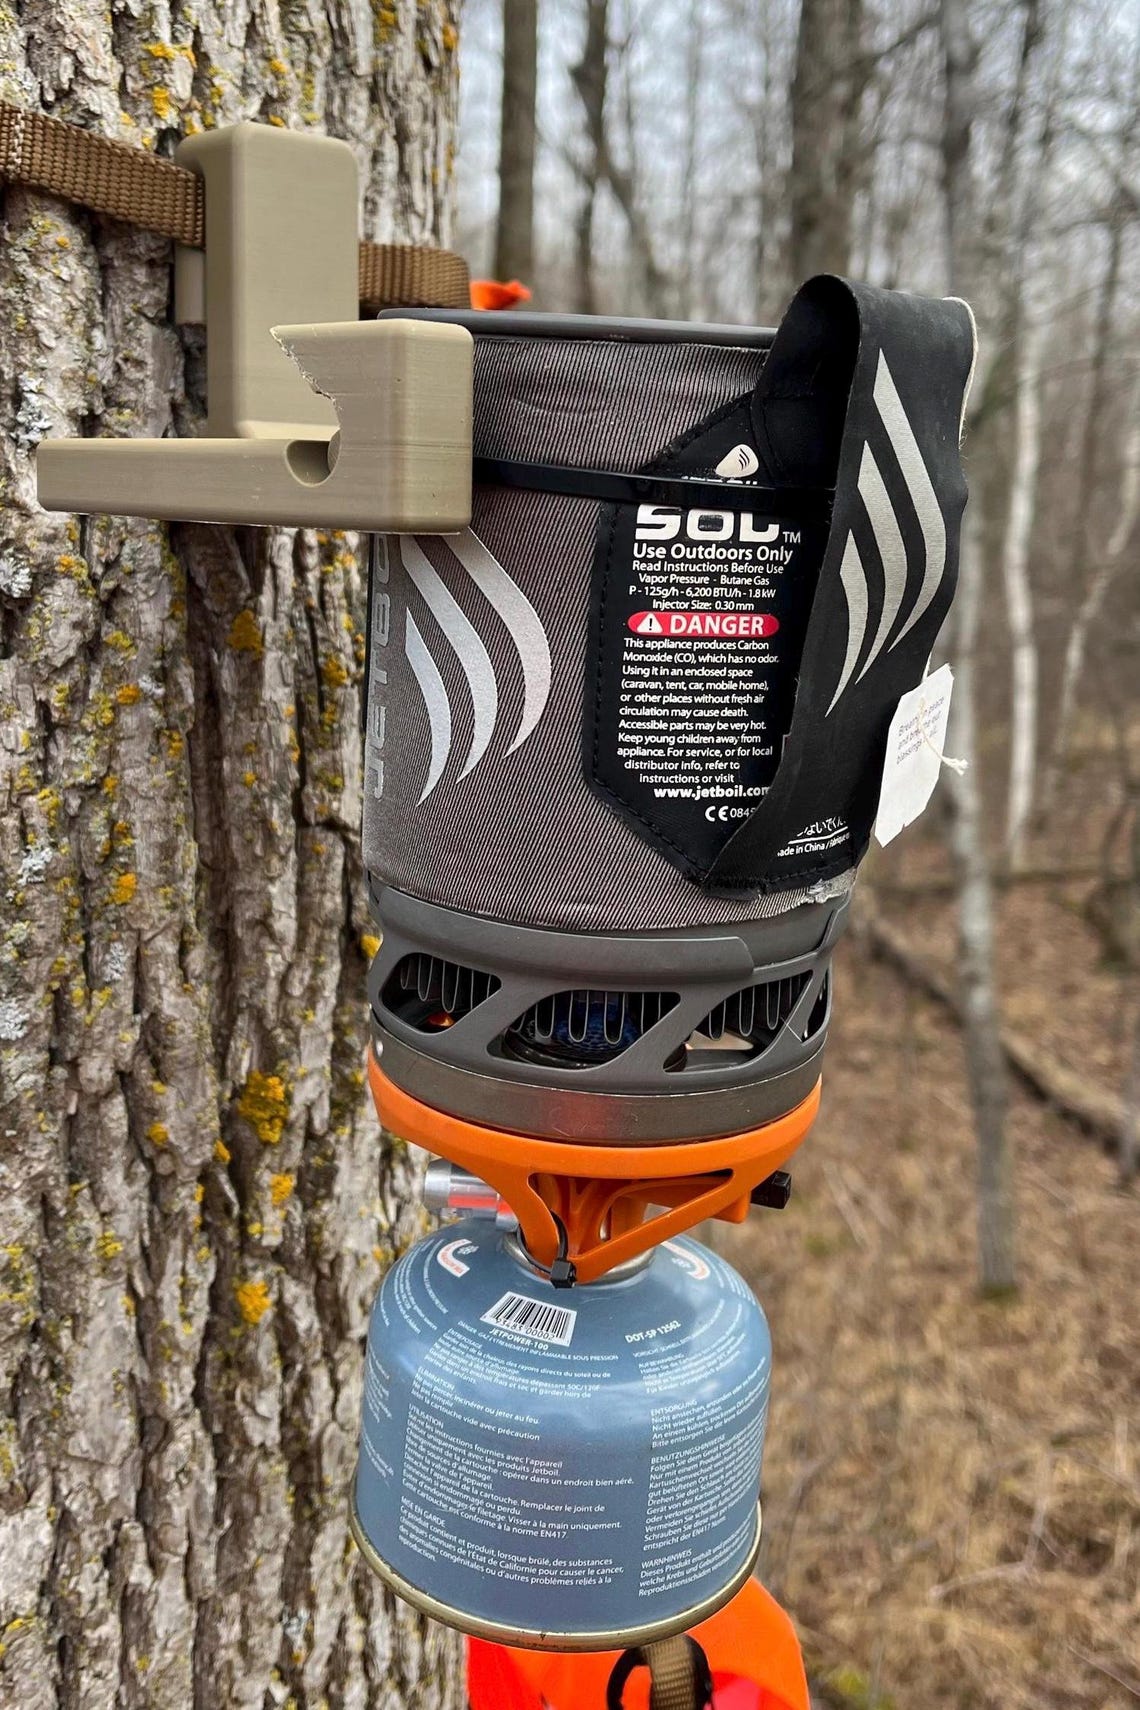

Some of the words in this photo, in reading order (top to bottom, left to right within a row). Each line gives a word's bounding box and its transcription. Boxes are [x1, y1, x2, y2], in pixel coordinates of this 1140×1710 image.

[635, 504, 780, 542] SOL
[633, 542, 666, 558] Use
[671, 544, 752, 560] Outdoors
[757, 546, 793, 564] Only
[632, 560, 660, 570] Read
[664, 561, 728, 572] Instructions
[731, 562, 764, 573] Before
[766, 564, 784, 574] Use
[639, 573, 668, 584] Vapor
[670, 574, 710, 584] Pressure
[720, 575, 752, 585] Butane
[754, 576, 770, 586] Gas
[645, 586, 679, 598] 125g/h
[713, 588, 742, 598] BTU/h
[761, 589, 776, 598] kW
[652, 599, 690, 611] Injector
[690, 600, 712, 610] Size:
[715, 601, 735, 611] 0.30
[736, 602, 754, 611] mm
[670, 614, 764, 635] DANGER
[624, 638, 644, 648] This
[644, 638, 692, 650] appliance
[694, 640, 736, 651] produces
[738, 640, 769, 650] Carbon
[623, 651, 673, 662] Monoxide
[674, 652, 696, 664] (CO),
[698, 653, 726, 663] which
[728, 654, 744, 664] has
[744, 656, 757, 664] no
[758, 654, 779, 664] odor.
[367, 533, 390, 799] JETBO
[622, 664, 650, 678] Using
[652, 666, 658, 676] it
[660, 666, 670, 676] in
[670, 668, 683, 676] an
[684, 666, 726, 677] enclosed
[728, 668, 754, 679] space
[621, 679, 664, 690] (caravan,
[666, 680, 687, 690] tent,
[688, 682, 705, 691] car,
[706, 680, 738, 690] mobile
[620, 694, 632, 702] or
[634, 692, 662, 702] other
[662, 693, 692, 704] places
[694, 694, 730, 704] without
[731, 694, 752, 704] fresh
[754, 694, 764, 703] air
[619, 706, 670, 716] circulation
[670, 708, 691, 719] may
[692, 709, 720, 717] cause
[720, 707, 748, 717] death.
[618, 720, 668, 730] Accessible
[670, 721, 694, 732] parts
[695, 722, 716, 732] may
[716, 721, 729, 730] be
[730, 722, 750, 732] very
[750, 720, 766, 730] hot.
[618, 732, 643, 744] Keep
[644, 735, 676, 746] young
[676, 734, 714, 744] children
[716, 736, 738, 745] away
[740, 734, 761, 743] from
[617, 746, 666, 758] appliance.
[667, 747, 684, 756] For
[685, 746, 722, 758] service,
[737, 746, 751, 756] for
[752, 746, 773, 756] local
[624, 760, 680, 770] distributor
[705, 760, 728, 770] refer
[730, 761, 740, 770] to
[640, 774, 700, 784] instructions
[702, 775, 712, 783] or
[714, 774, 734, 783] visit
[777, 847, 794, 857] ade
[804, 842, 825, 852] China
[489, 1328, 548, 1350] JETPOWER-100
[434, 1428, 473, 1449] instructions
[474, 1444, 504, 1459] fournies
[506, 1455, 524, 1463] avec
